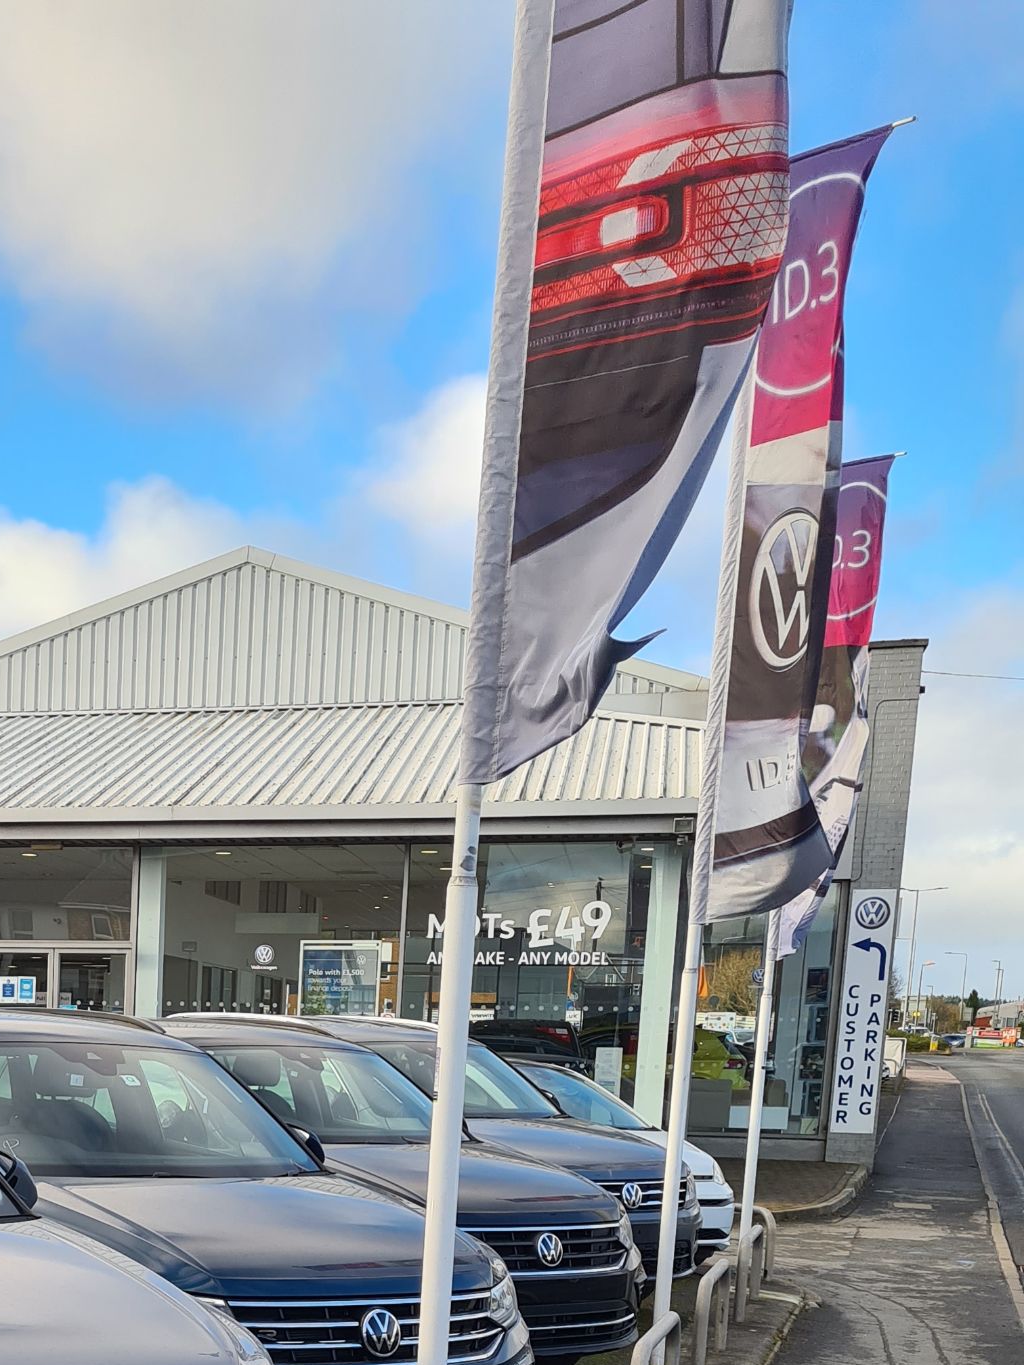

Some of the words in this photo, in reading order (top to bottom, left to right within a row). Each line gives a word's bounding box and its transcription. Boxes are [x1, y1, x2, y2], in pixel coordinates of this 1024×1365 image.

[426, 913, 515, 939] MTs
[526, 901, 612, 948] £49
[475, 951, 505, 965] AKE
[518, 951, 551, 965] ANY
[554, 951, 609, 965] MODEL
[835, 984, 860, 1124] CUSTOMER
[859, 993, 881, 1116] PARKING
